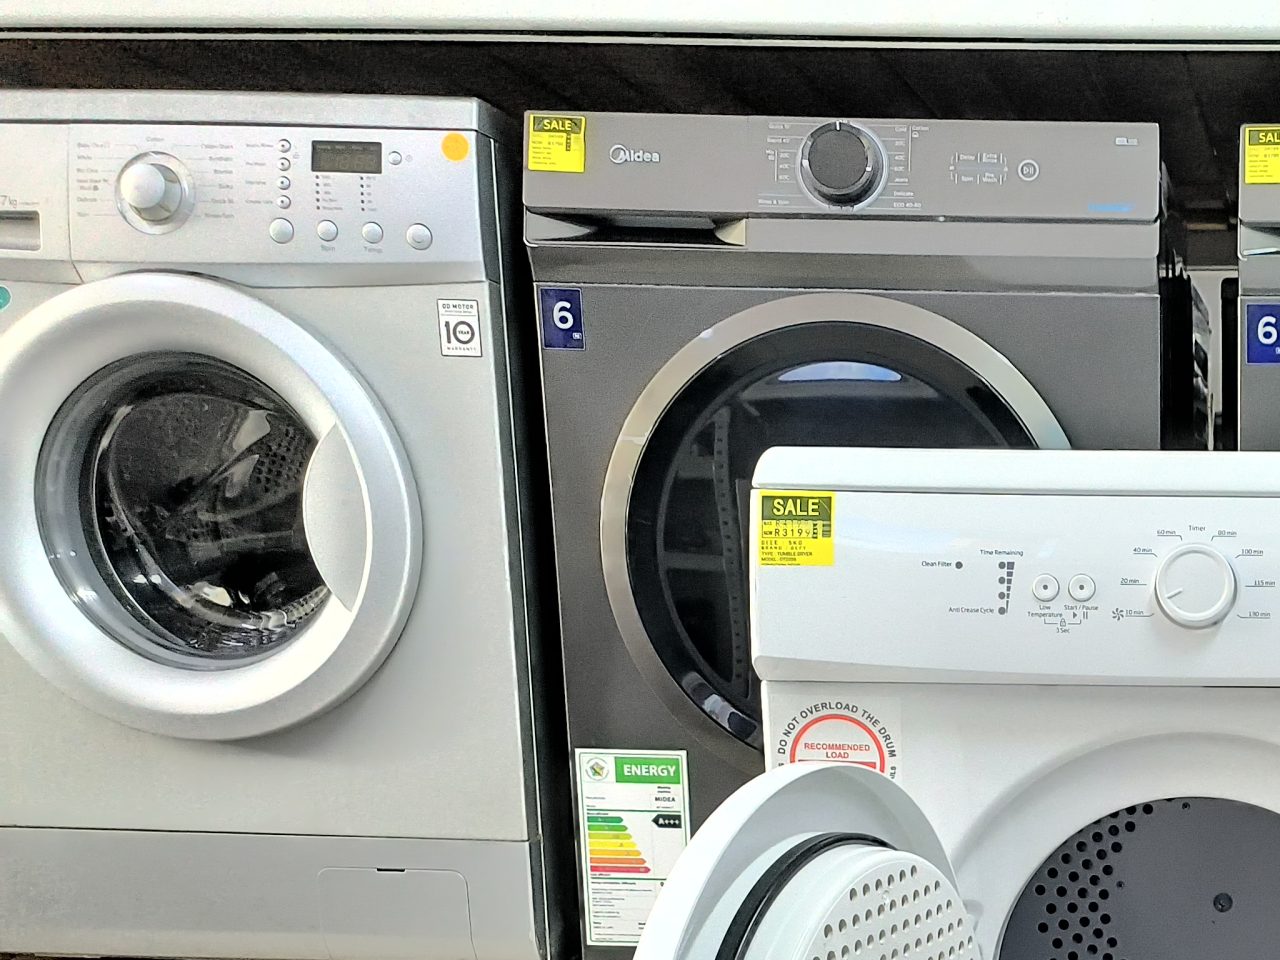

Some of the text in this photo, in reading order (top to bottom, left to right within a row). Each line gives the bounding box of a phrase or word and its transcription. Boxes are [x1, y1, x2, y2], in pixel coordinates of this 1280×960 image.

[544, 120, 572, 130] SALE
[610, 144, 660, 163] Midea
[553, 301, 574, 329] 6
[445, 320, 475, 344] 10
[1258, 316, 1278, 345] 6
[773, 499, 820, 516] SALE
[778, 702, 896, 758] DO NOT OVERLOAD THE DRUM
[804, 743, 870, 751] RECOMMENDED
[623, 764, 675, 776] ENERGY
